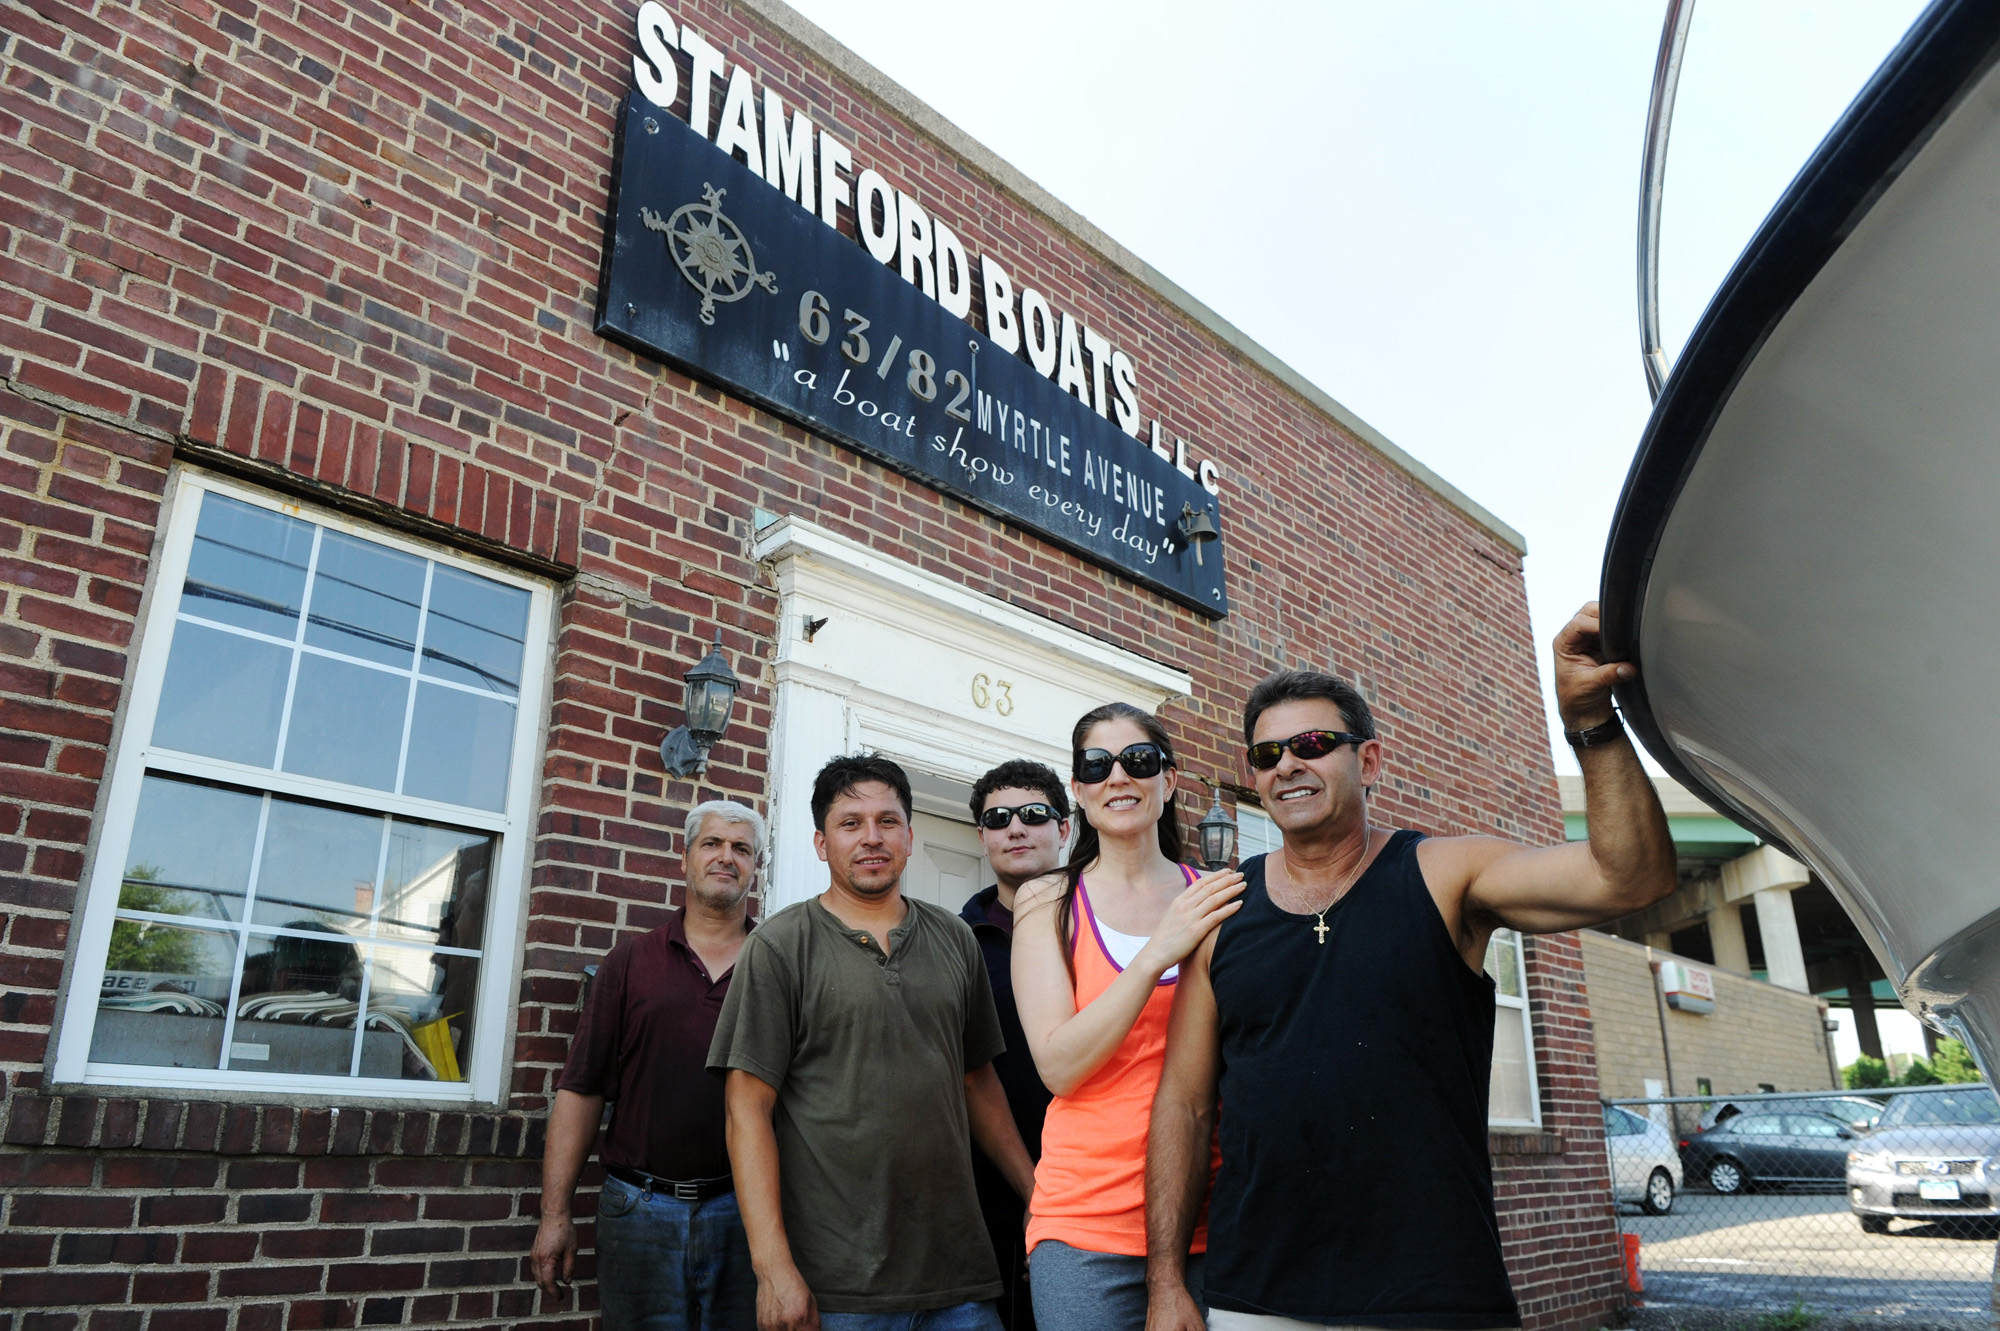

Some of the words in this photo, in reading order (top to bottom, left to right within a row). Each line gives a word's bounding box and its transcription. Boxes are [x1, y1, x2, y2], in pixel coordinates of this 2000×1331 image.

[633, 1, 971, 319] STAMFORD
[981, 254, 1140, 438] BOATS
[1151, 420, 1219, 496] LLC
[799, 290, 971, 422] 63/82
[977, 389, 1071, 476] MYRTLE
[1084, 449, 1166, 526] AVENUE
[832, 369, 916, 437] boat
[931, 427, 1015, 484] show
[1028, 485, 1102, 537] every
[971, 672, 1014, 717] 63
